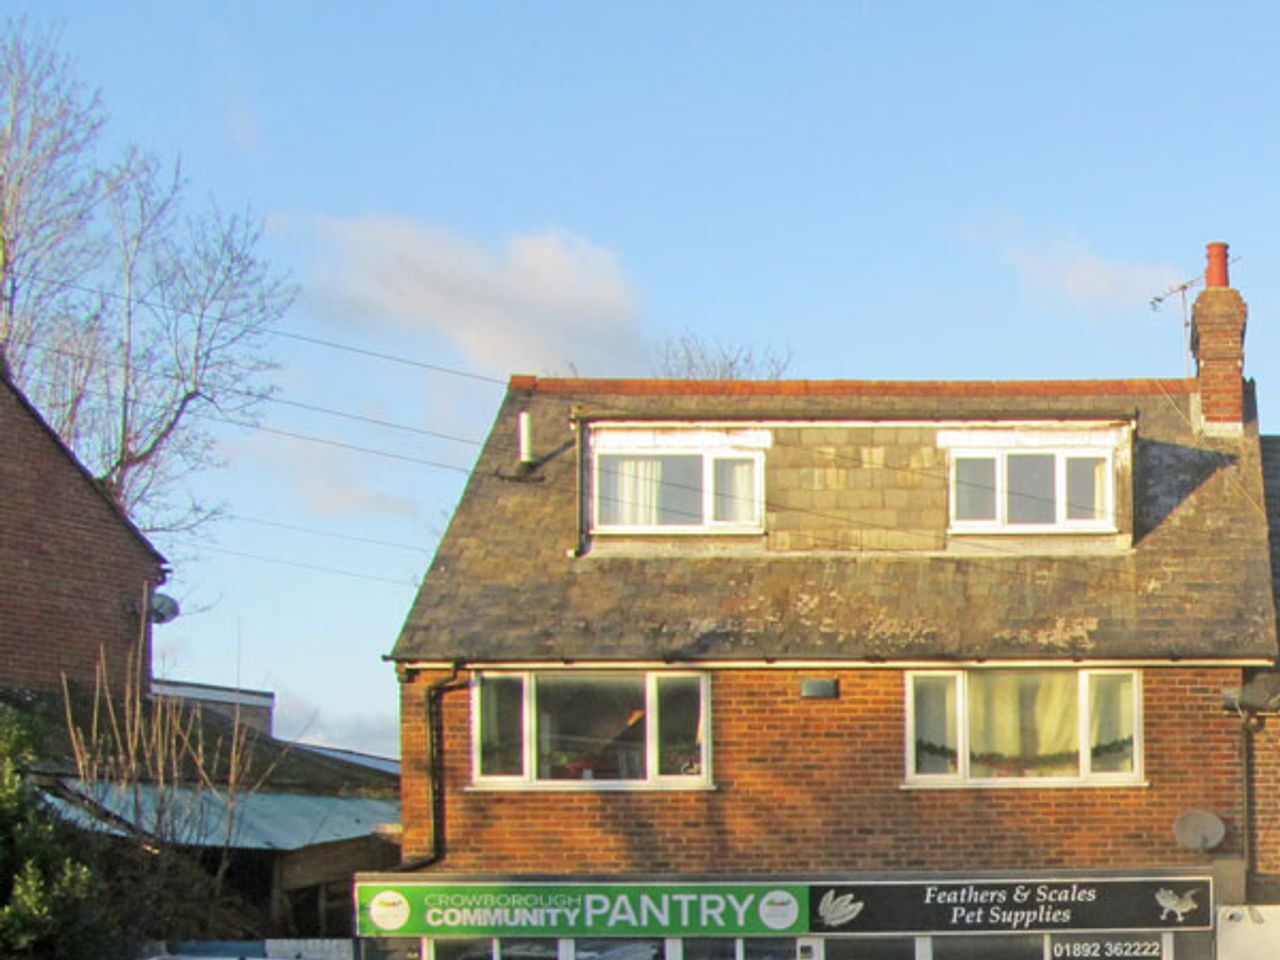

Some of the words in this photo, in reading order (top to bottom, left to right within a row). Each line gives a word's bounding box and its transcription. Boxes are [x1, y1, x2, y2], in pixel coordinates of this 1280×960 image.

[424, 893, 582, 908] CROWBOROUGH
[924, 885, 1007, 905] Feathers
[1013, 886, 1031, 903] &
[1035, 885, 1097, 903] Scales
[425, 908, 581, 928] COMMUNITY
[585, 893, 755, 928] PANTRY
[951, 907, 984, 925] Pet
[989, 906, 1072, 928] Supplies
[1053, 942, 1100, 958] 01892
[1105, 941, 1161, 958] 362222
